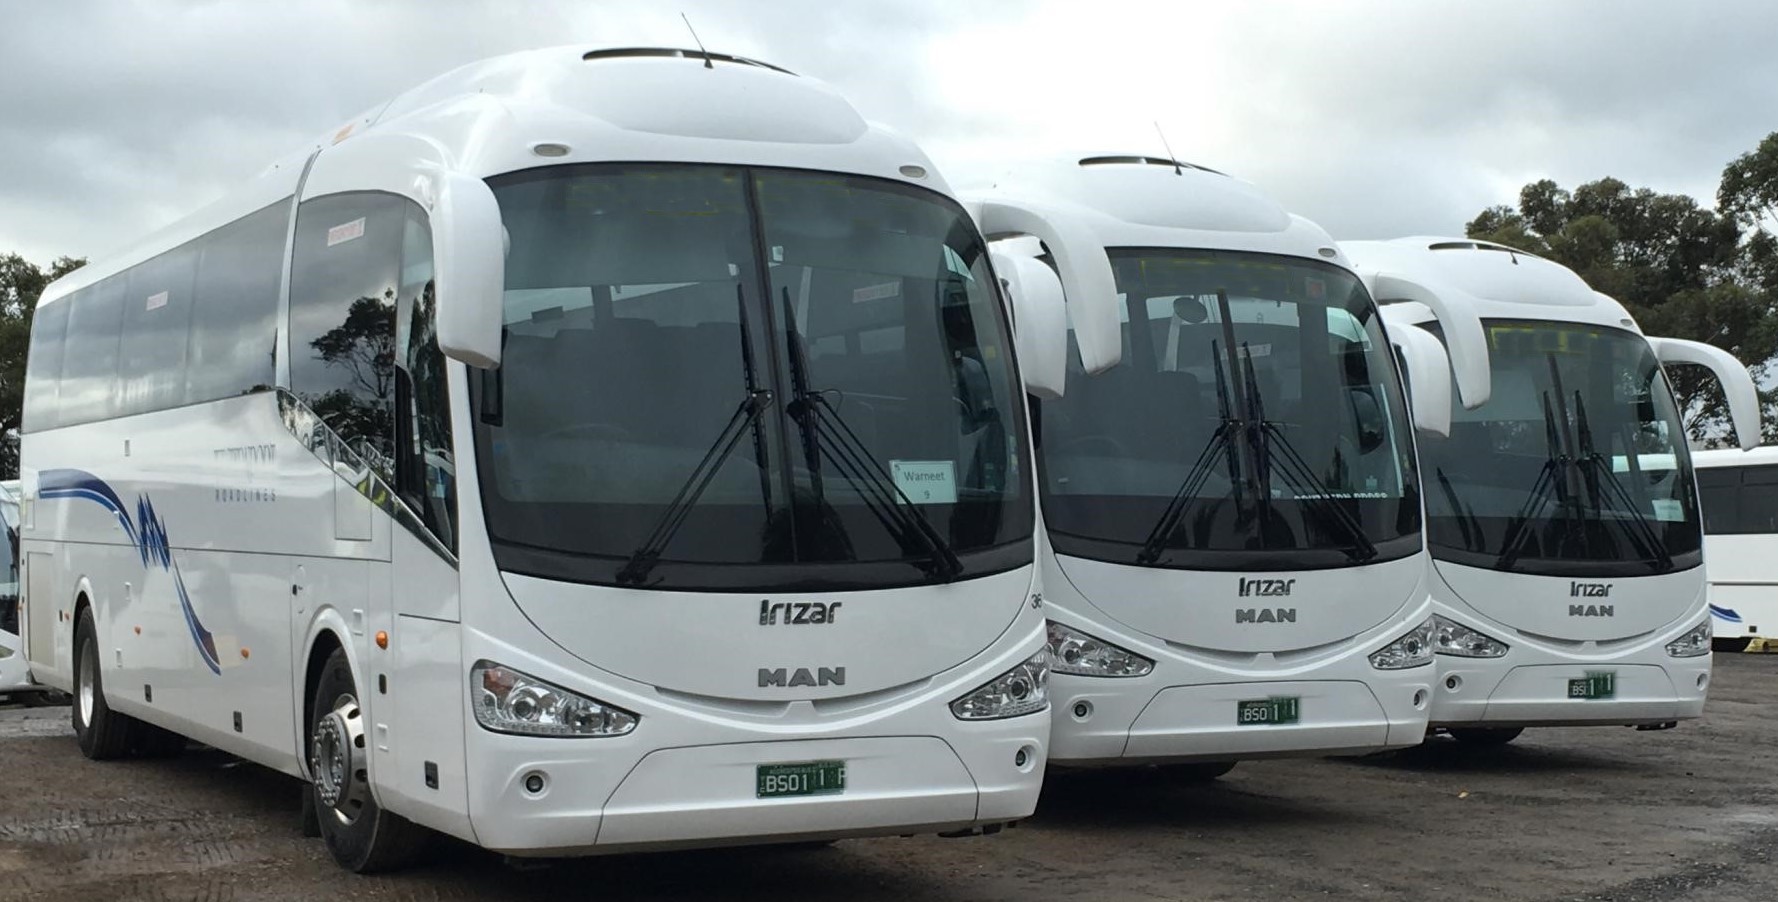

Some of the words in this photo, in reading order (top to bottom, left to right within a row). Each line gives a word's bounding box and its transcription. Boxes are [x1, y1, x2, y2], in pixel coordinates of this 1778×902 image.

[1239, 577, 1296, 597] Irizar
[1570, 581, 1613, 597] Irizar
[1031, 593, 1042, 609] 36
[759, 599, 842, 626] Irizar
[1235, 608, 1297, 623] MAN
[1569, 605, 1614, 616] MAN
[758, 666, 845, 687] MAN
